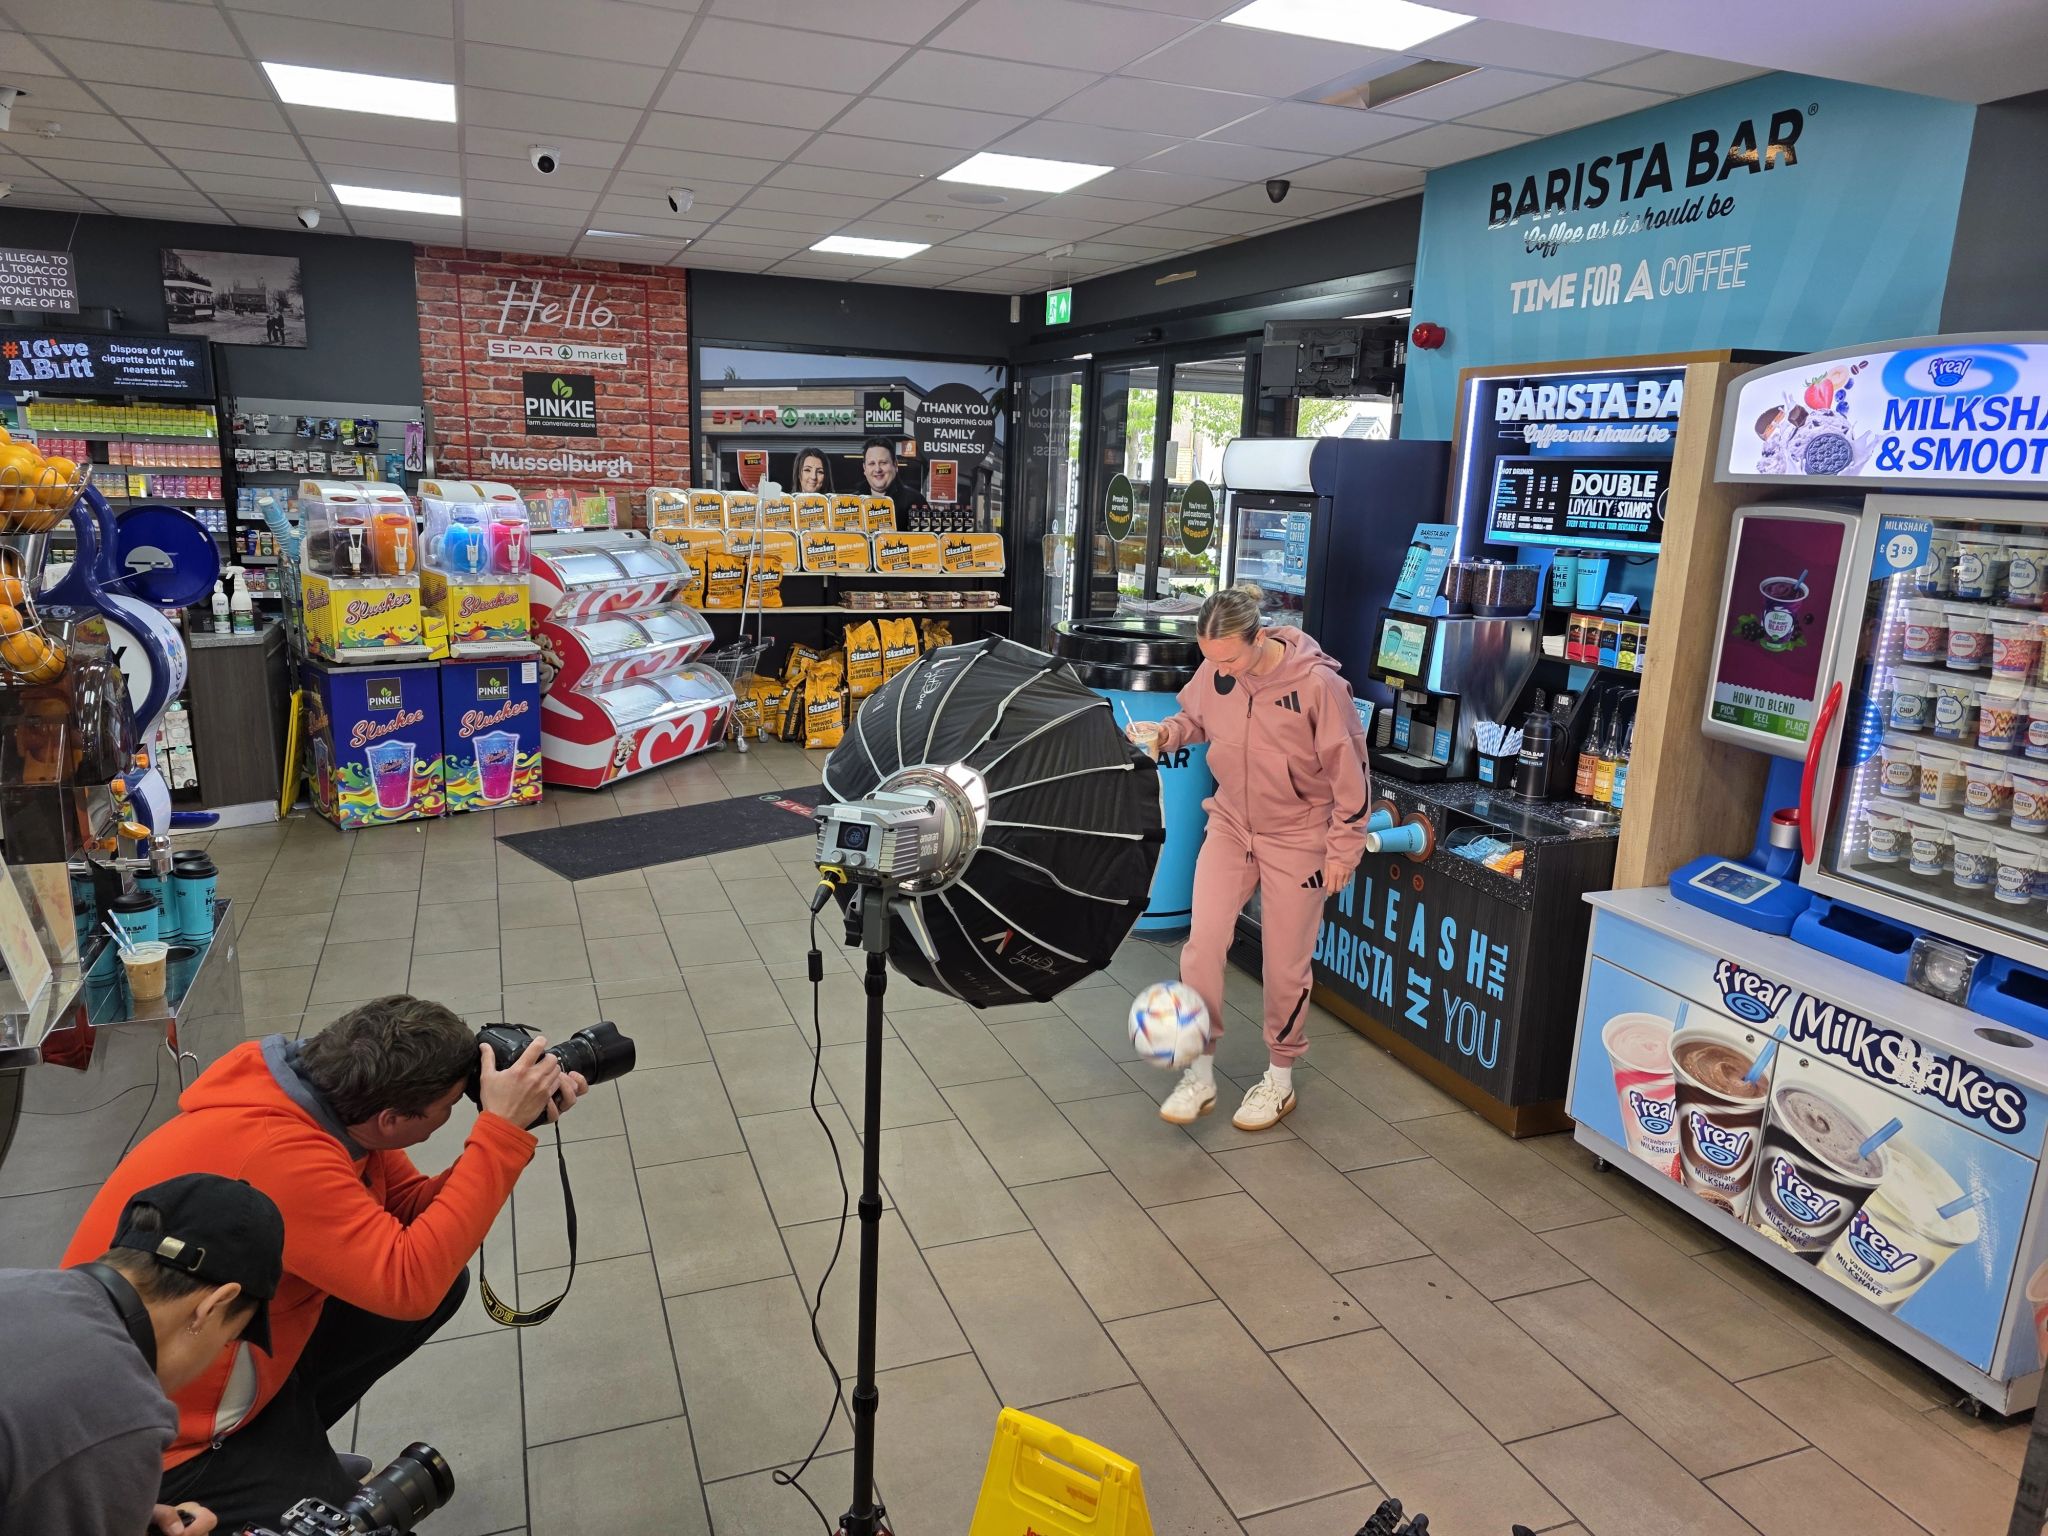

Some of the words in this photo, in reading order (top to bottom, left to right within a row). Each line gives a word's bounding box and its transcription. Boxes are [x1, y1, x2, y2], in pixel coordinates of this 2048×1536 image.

[1488, 142, 1673, 230] BARISTA
[1524, 221, 1584, 258] Coffee
[1586, 222, 1609, 240] as
[1630, 196, 1702, 232] should
[1708, 193, 1735, 217] be
[6, 252, 50, 264] ILLEGAL
[51, 256, 68, 265] TO
[10, 263, 67, 276] TOBACCO
[50, 277, 67, 287] TO
[1510, 272, 1577, 314] TIME
[1581, 263, 1622, 308] FOR
[1624, 259, 1654, 302] A
[1660, 244, 1751, 297] COFFEE
[34, 287, 75, 299] UNDER
[14, 297, 37, 307] AGE
[40, 299, 55, 308] OF
[60, 300, 71, 309] 18
[497, 281, 613, 334] Hello
[110, 344, 148, 357] Dispose
[150, 346, 161, 355] of
[162, 348, 183, 358] your
[491, 343, 553, 357] SPAR
[577, 350, 624, 362] market
[101, 355, 143, 366] cigarette
[146, 356, 166, 365] butt
[168, 357, 177, 366] in
[179, 358, 195, 367] the
[123, 365, 158, 375] nearest
[161, 366, 176, 376] bin
[1494, 382, 1630, 421] BARISTA
[525, 397, 595, 419] PINKIE
[922, 401, 962, 414] THANK
[964, 404, 989, 415] YOU
[712, 409, 777, 425] SPAR
[803, 410, 857, 426] market
[865, 410, 902, 422] PINKIE
[916, 416, 932, 424] FOR
[932, 417, 977, 426] SUPPORTING
[542, 419, 580, 428] convenience
[580, 421, 596, 429] store
[934, 428, 975, 440] FAMILY
[1523, 423, 1570, 449] Coffee
[1594, 424, 1648, 442] should
[1647, 424, 1671, 443] be
[923, 441, 985, 454] BUSINESS!
[491, 451, 633, 477] Musselburgh
[1570, 473, 1658, 498] DOUBLE
[658, 503, 684, 512] Sizzler
[694, 504, 720, 512] Sizzler
[730, 505, 756, 515] Sizzler
[766, 506, 790, 515] Sizzler
[799, 506, 825, 515] Sizzler
[835, 506, 859, 515] Sizzler
[868, 509, 890, 517] Sizzler
[1567, 498, 1614, 517] LOYALTY
[1617, 501, 1653, 519] STAMPS
[1497, 512, 1517, 521] FREE
[1290, 522, 1306, 530] ICED
[1638, 524, 1649, 532] CUP
[1885, 521, 1929, 533] MILKSHAKE
[1420, 529, 1439, 537] BARISTA
[806, 544, 835, 555] Sizzler
[880, 545, 909, 557] Sizzler
[945, 545, 971, 557] Sizzler
[1880, 544, 1886, 554] £
[711, 570, 742, 580] Sizzler
[345, 591, 413, 625] Slushee
[458, 590, 519, 618] Slushee
[1768, 623, 1787, 632] BLAST
[851, 650, 880, 661] Sizzler
[886, 647, 915, 659] Sizzler
[478, 686, 508, 697] PINKIE
[369, 695, 401, 706] PINKIE
[1733, 691, 1752, 705] HOW
[1755, 695, 1765, 709] TO
[1767, 699, 1795, 715] BLEND
[808, 700, 839, 714] Sizzler
[1720, 704, 1735, 716] PICK
[458, 700, 529, 738] Slushee
[1753, 712, 1769, 725] PEEL
[350, 709, 424, 748] Slushee
[1785, 720, 1808, 733] PLACE
[1382, 788, 1397, 801] LARGE
[1968, 790, 1988, 798] SALTED
[920, 832, 939, 843] amaran
[1312, 919, 1394, 1008] BARISTA
[1486, 944, 1509, 1002] THE
[1404, 967, 1432, 1030] IN
[1443, 988, 1500, 1070] YOU
[1642, 1135, 1673, 1147] strawberry
[1640, 1142, 1676, 1154] MILKSHAKE
[1700, 1163, 1736, 1183] chocolate
[1695, 1167, 1740, 1193] MILKSHAKE
[1764, 1207, 1809, 1248] MILKSHAKE
[1794, 1226, 1817, 1242] cream
[1835, 1252, 1883, 1298] MILKSHAKE
[1849, 1258, 1875, 1283] vanilla
